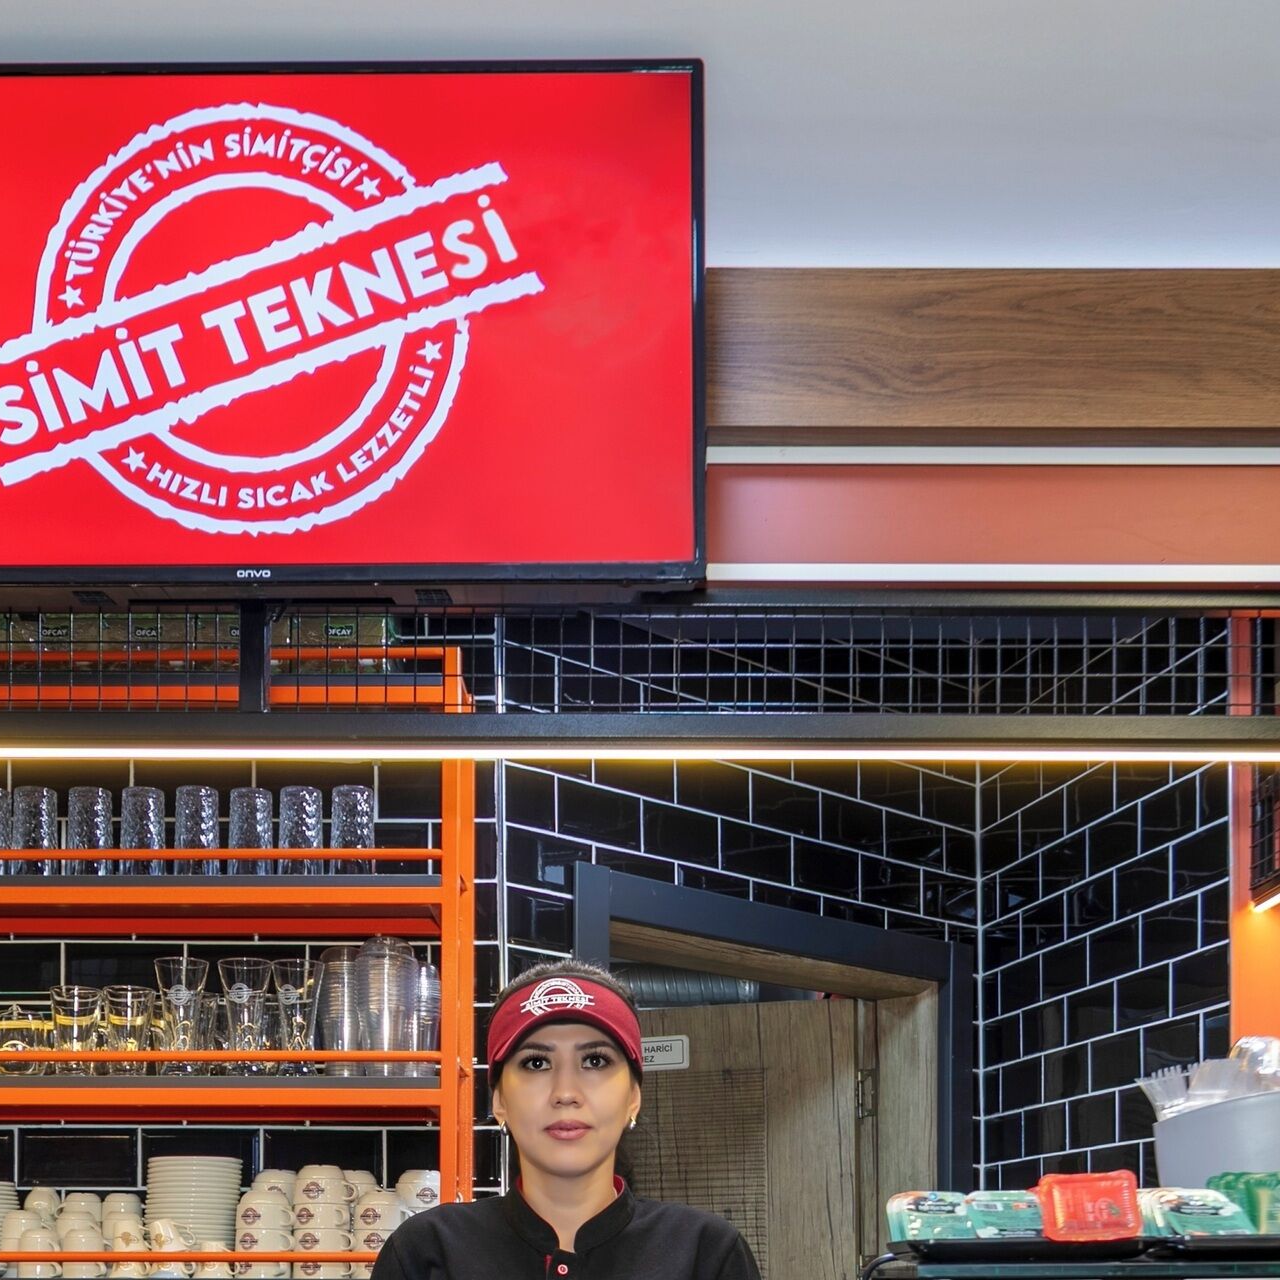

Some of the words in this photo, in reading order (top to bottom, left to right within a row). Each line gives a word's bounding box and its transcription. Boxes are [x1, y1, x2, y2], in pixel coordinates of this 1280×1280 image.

[63, 141, 215, 282] TÜRKİYE'NİN
[223, 125, 366, 192] SİMİTÇİSİ
[204, 194, 520, 367] TEKNESİ
[145, 460, 228, 509] HIZLI
[236, 471, 335, 510] SICAK
[335, 362, 436, 488] LEZZETLİ
[644, 1044, 673, 1054] HARİCİ
